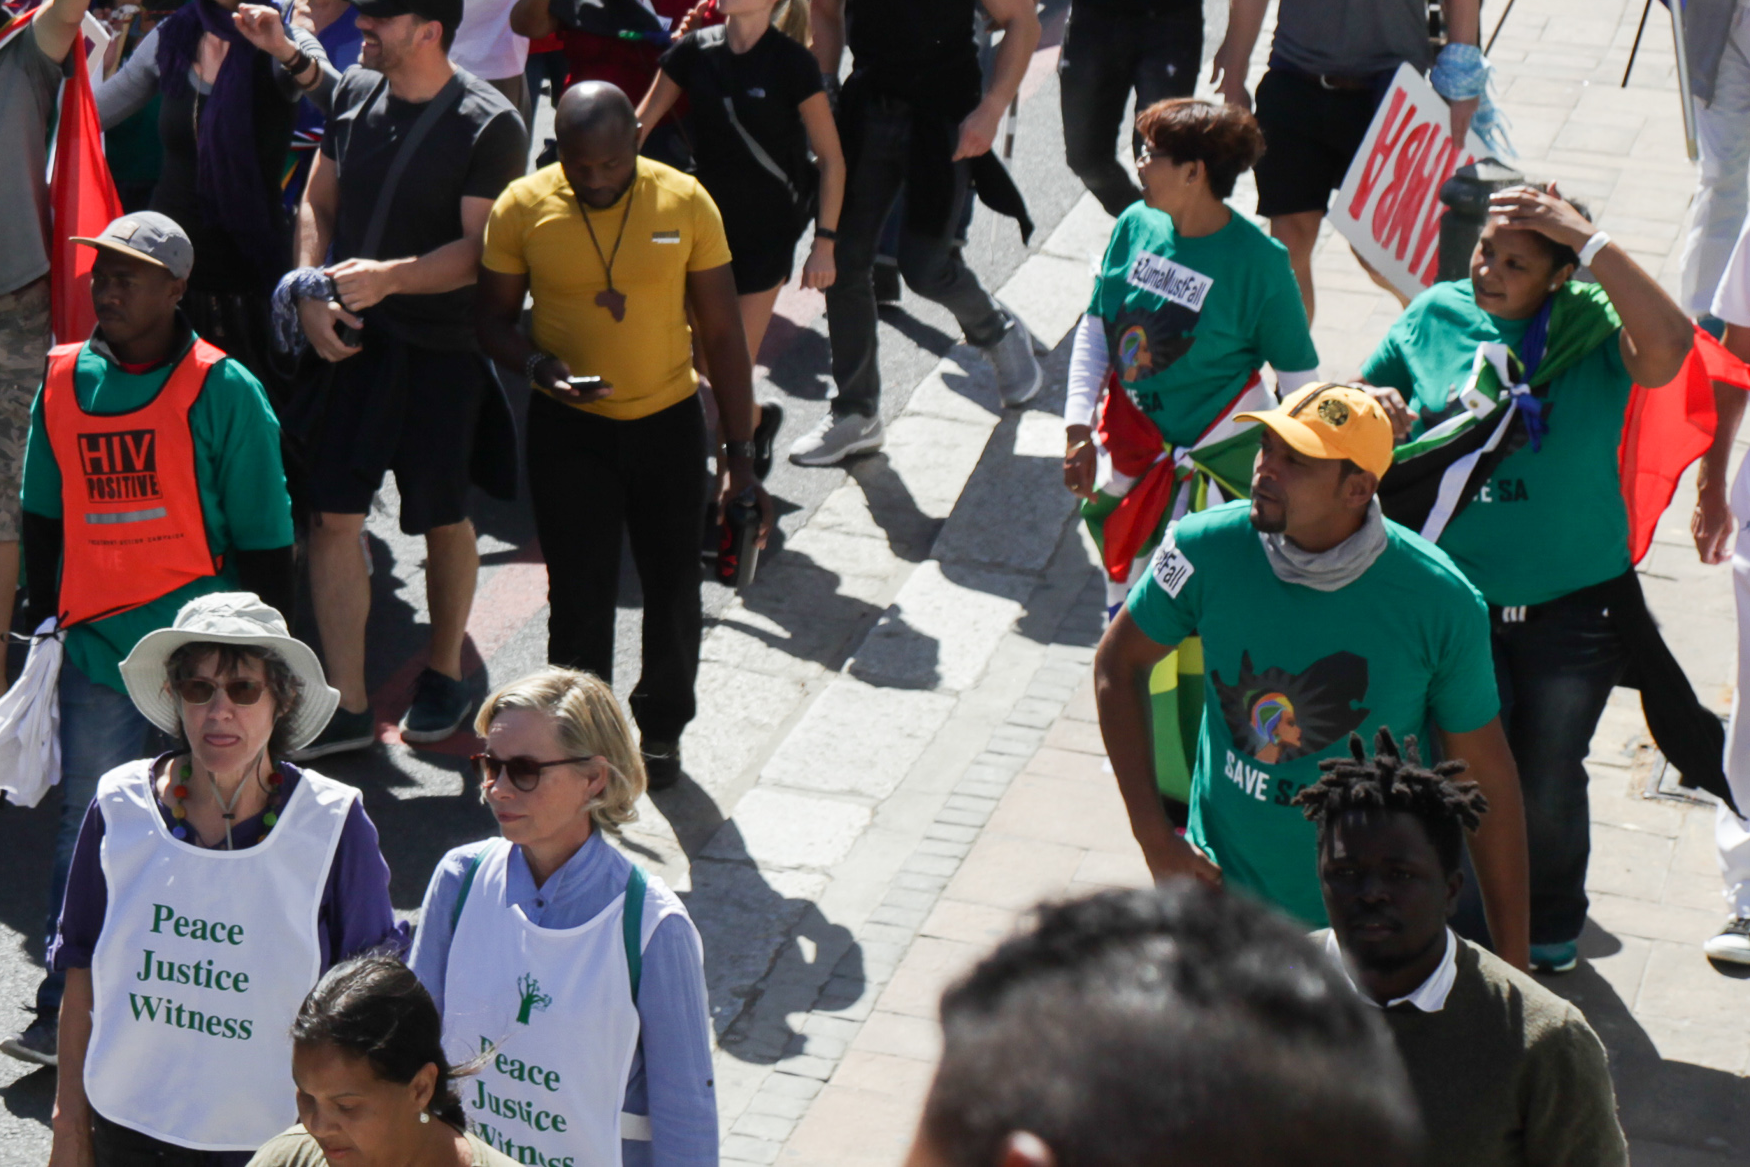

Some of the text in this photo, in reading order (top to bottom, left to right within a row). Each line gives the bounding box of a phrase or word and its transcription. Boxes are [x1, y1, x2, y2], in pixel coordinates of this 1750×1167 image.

[80, 433, 153, 474] HIV
[86, 474, 160, 500] POSITIVE
[1498, 479, 1529, 503] SA
[1224, 748, 1271, 802] SAVE
[149, 903, 245, 946] Peace
[136, 948, 250, 993] Justice
[128, 991, 254, 1041] Witness
[471, 1078, 568, 1133] Justice
